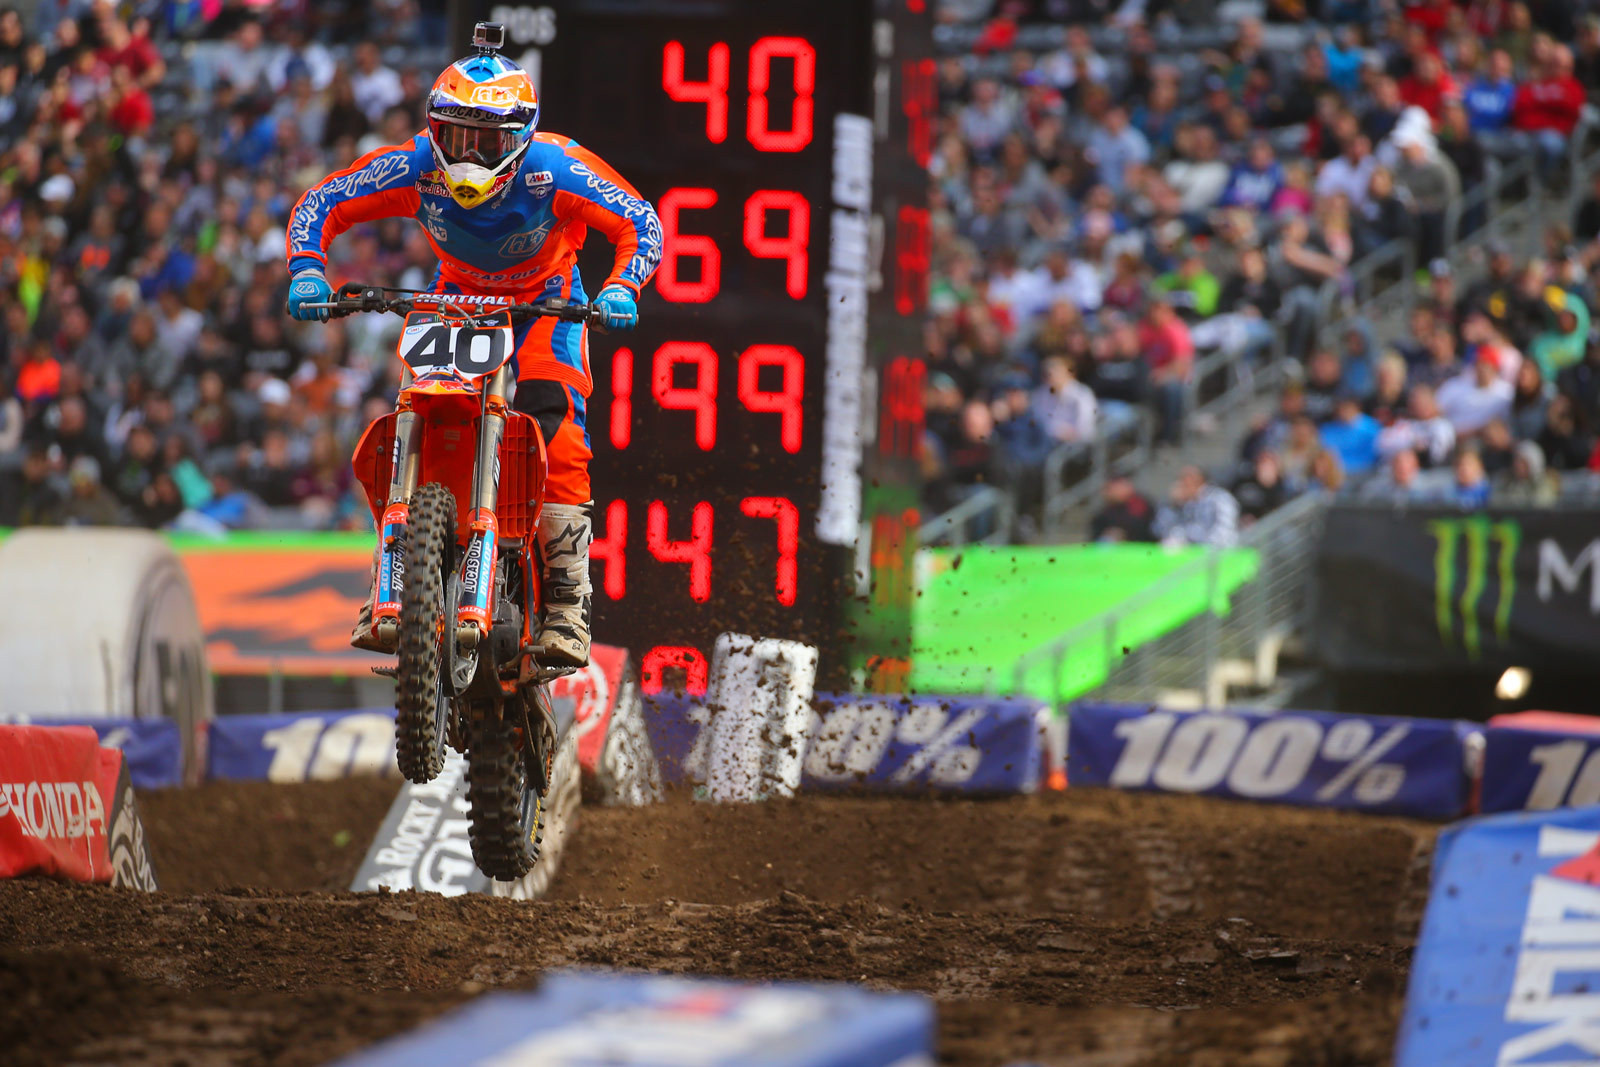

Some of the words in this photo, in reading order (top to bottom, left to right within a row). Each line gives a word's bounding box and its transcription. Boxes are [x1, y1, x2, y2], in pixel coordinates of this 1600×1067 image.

[662, 36, 816, 152] 40
[434, 185, 453, 198] Bul
[655, 187, 810, 304] 69
[416, 294, 510, 306] RENTHAL
[404, 325, 506, 375] 40
[610, 340, 804, 454] 199
[464, 558, 481, 595] LUCAS
[479, 541, 492, 598] DUNLOP
[1109, 713, 1412, 804] 100%
[2, 781, 107, 840] HONDA
